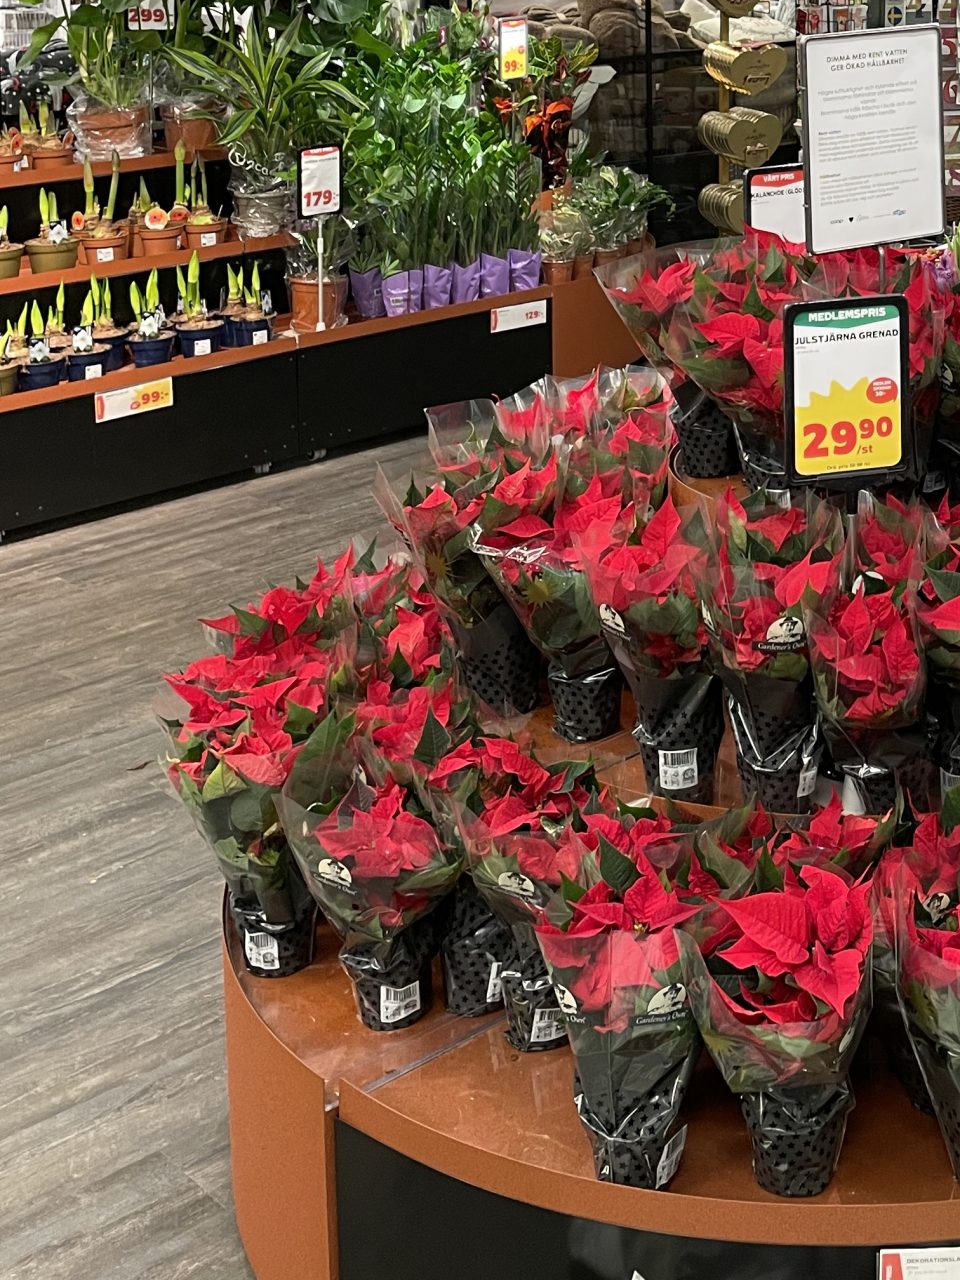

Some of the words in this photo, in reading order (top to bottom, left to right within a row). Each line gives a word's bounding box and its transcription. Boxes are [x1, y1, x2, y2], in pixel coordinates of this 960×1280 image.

[826, 55, 851, 64] DIMMA
[852, 52, 867, 61] MED
[868, 50, 883, 59] RENT
[884, 48, 908, 57] VATTEN
[830, 64, 844, 72] GER
[845, 61, 866, 70] ÖKAD
[866, 57, 905, 67] HÅLLBARHET
[763, 174, 780, 183] VÅRT
[780, 173, 795, 181] PRIS
[808, 307, 886, 323] MEDLEMSPRIS
[795, 332, 857, 345] JULSTJÄRNA
[858, 329, 899, 340] GRENAD
[757, 642, 791, 651] Gardener's
[635, 1015, 671, 1025] Gardener's
